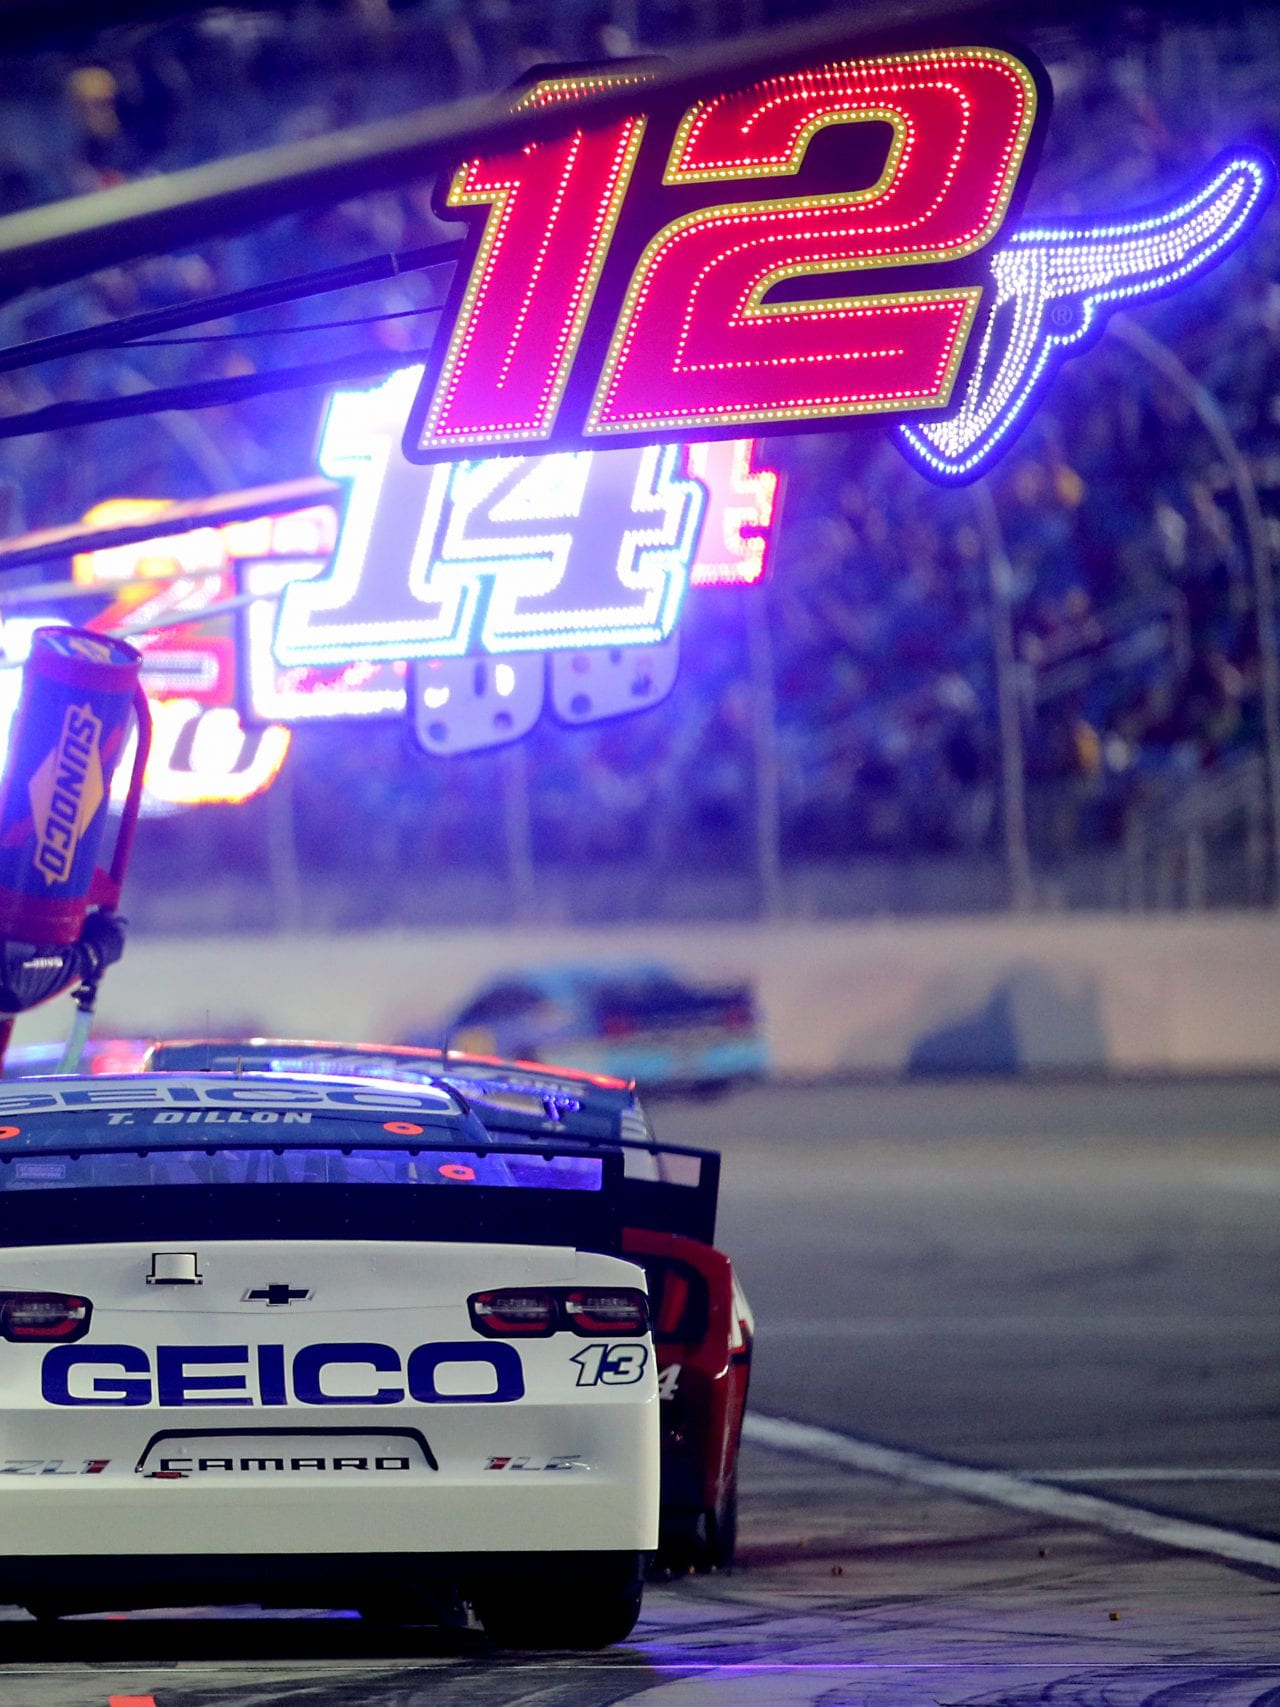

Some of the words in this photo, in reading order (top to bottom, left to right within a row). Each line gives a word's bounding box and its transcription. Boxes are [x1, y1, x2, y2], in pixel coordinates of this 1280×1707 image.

[419, 46, 1038, 450] 12
[273, 366, 703, 667] 14
[39, 709, 96, 876] SUNOCO
[107, 1113, 134, 1126] T.
[153, 1111, 312, 1126] DILLON
[41, 1341, 525, 1407] GEICO
[569, 1343, 649, 1387] 13
[160, 1458, 411, 1472] CAMARO
